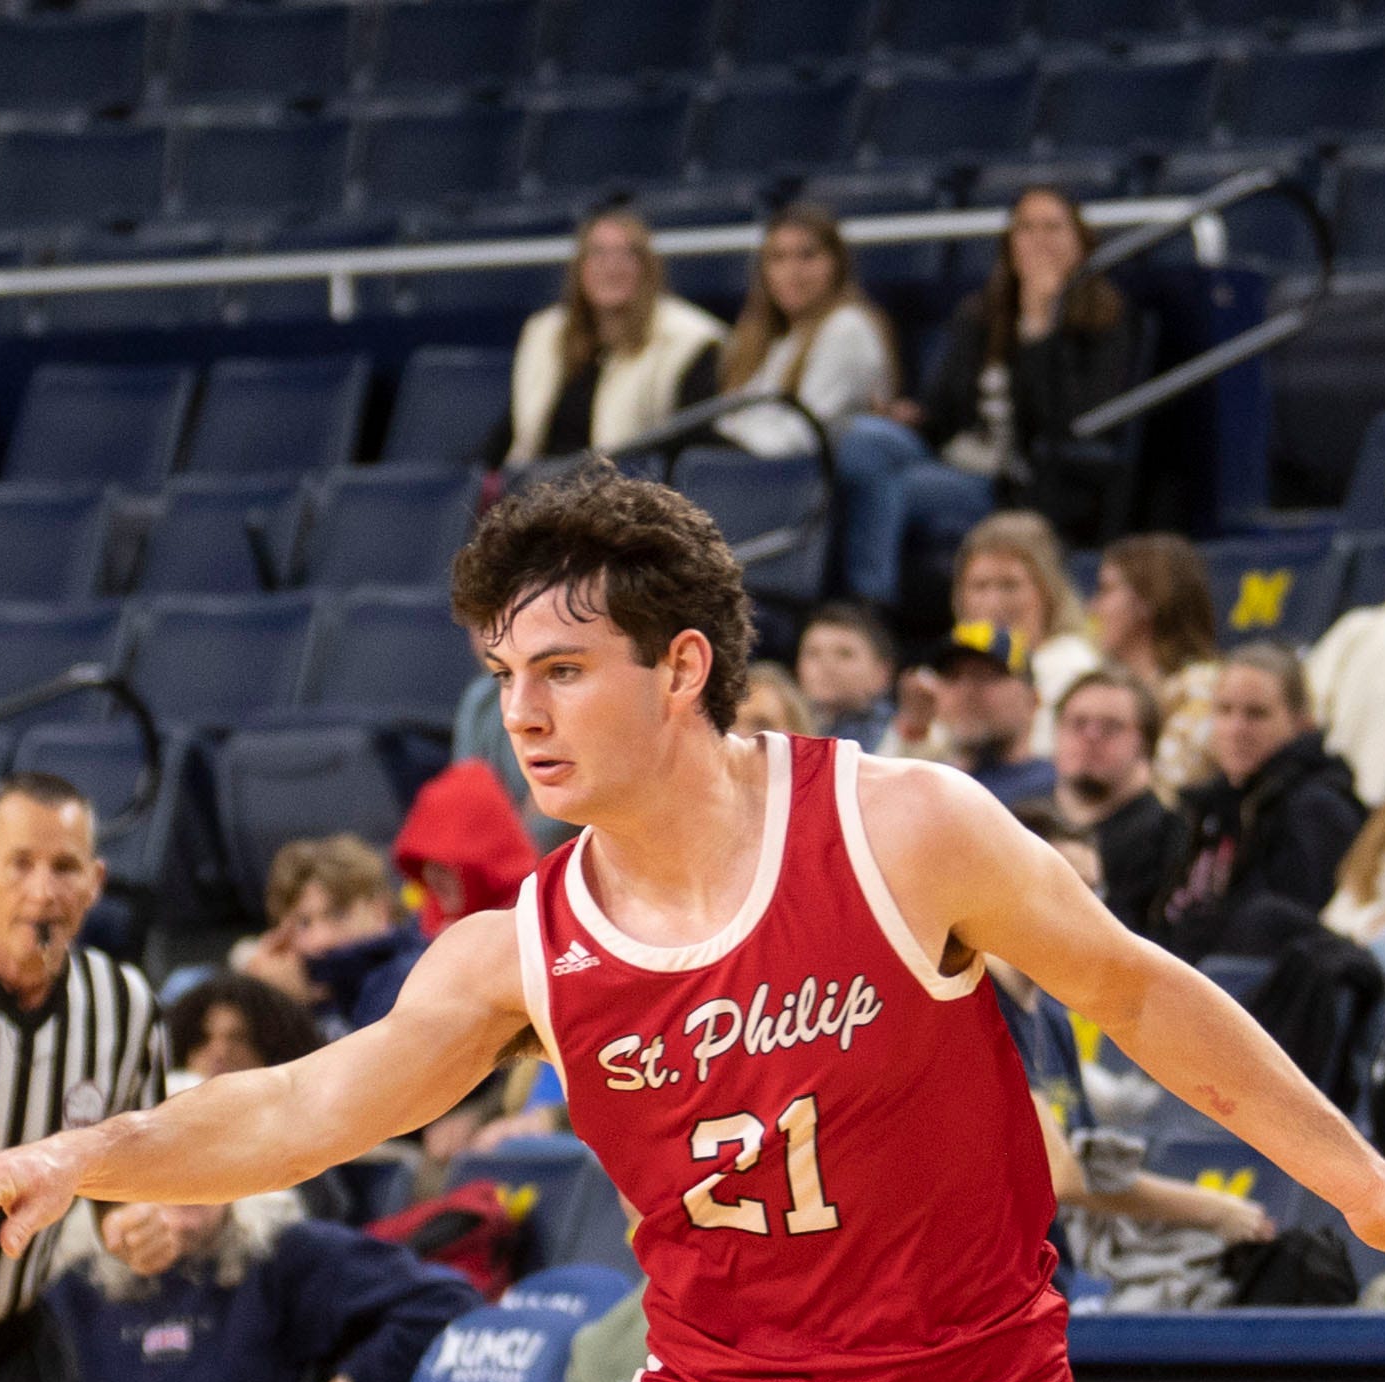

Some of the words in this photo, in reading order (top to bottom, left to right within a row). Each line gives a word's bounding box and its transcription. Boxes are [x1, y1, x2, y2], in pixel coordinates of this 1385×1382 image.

[1229, 568, 1293, 630] M
[550, 955, 602, 977] adidas
[596, 1033, 682, 1092] St.
[683, 973, 884, 1084] Philip
[681, 1092, 842, 1237] 21
